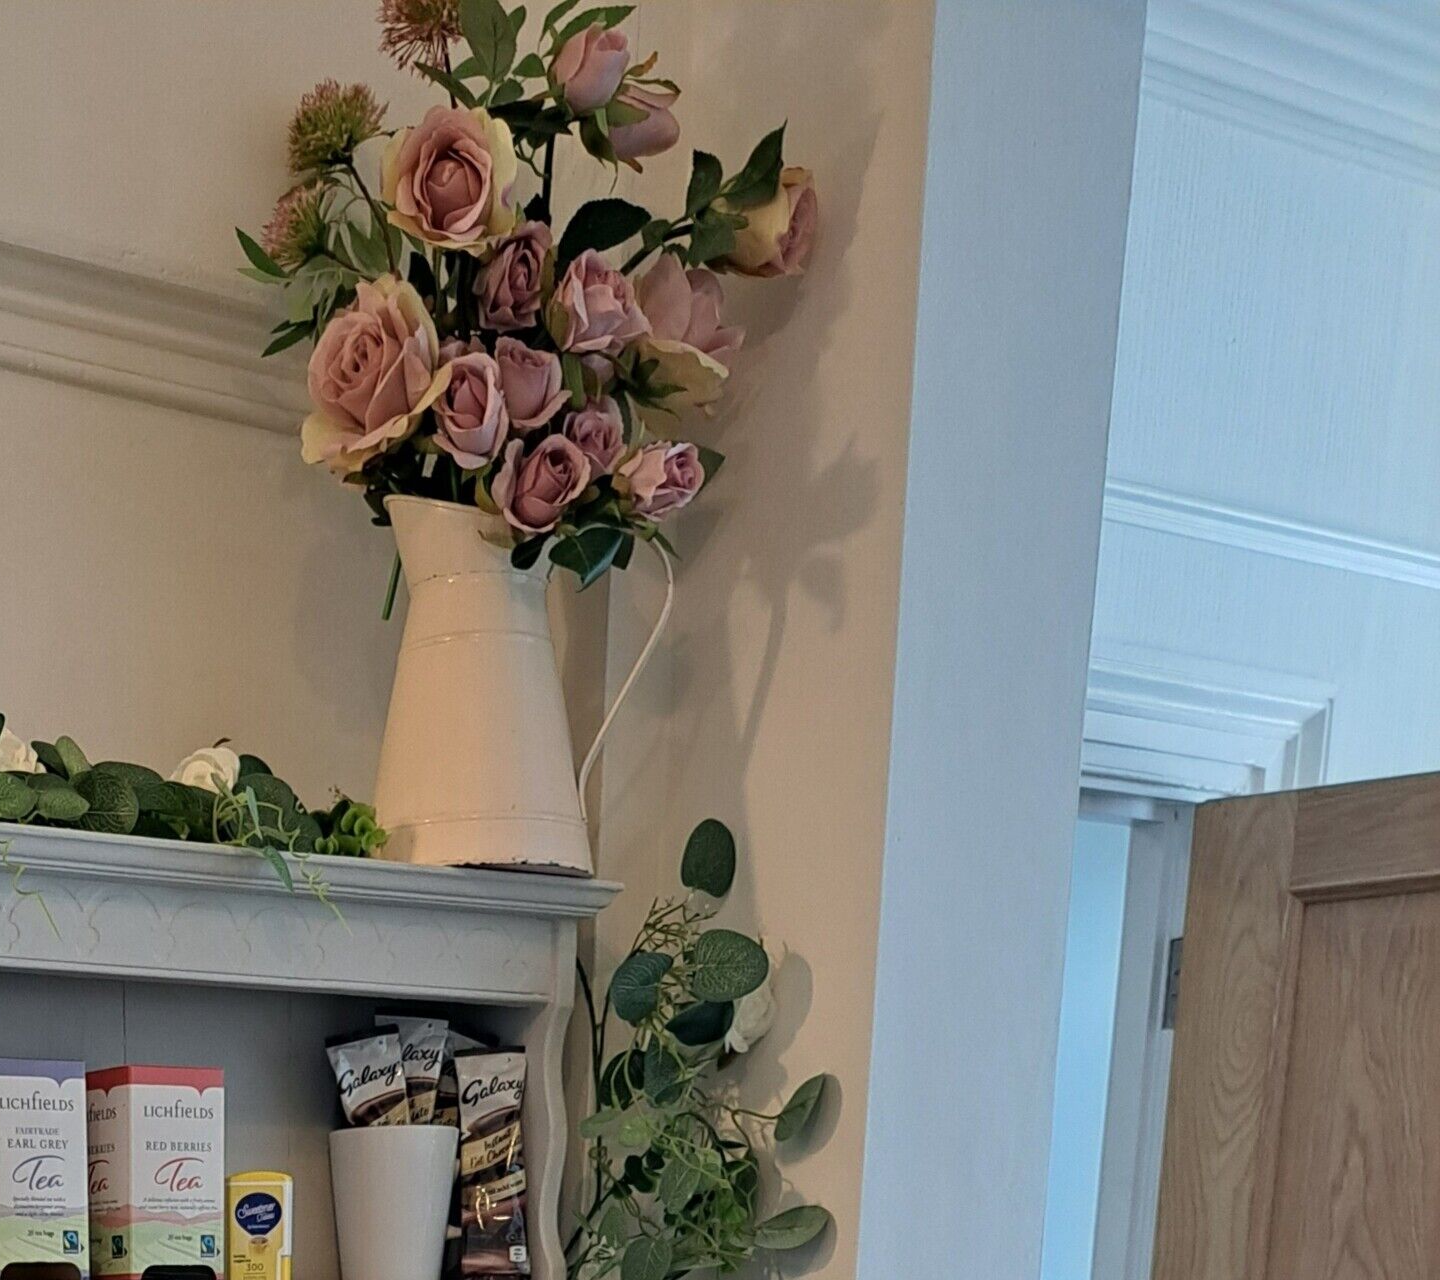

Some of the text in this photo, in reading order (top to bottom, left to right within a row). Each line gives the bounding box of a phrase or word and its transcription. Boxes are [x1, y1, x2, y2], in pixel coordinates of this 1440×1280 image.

[401, 1043, 441, 1072] laxy
[338, 1061, 399, 1098] Galaxy
[461, 1075, 524, 1107] Galaxy
[7, 1138, 70, 1151] EARL GREY
[145, 1141, 213, 1153] RED BERRIES
[12, 1154, 66, 1191] Tea
[154, 1156, 206, 1193] Tea
[246, 1262, 265, 1272] 300
